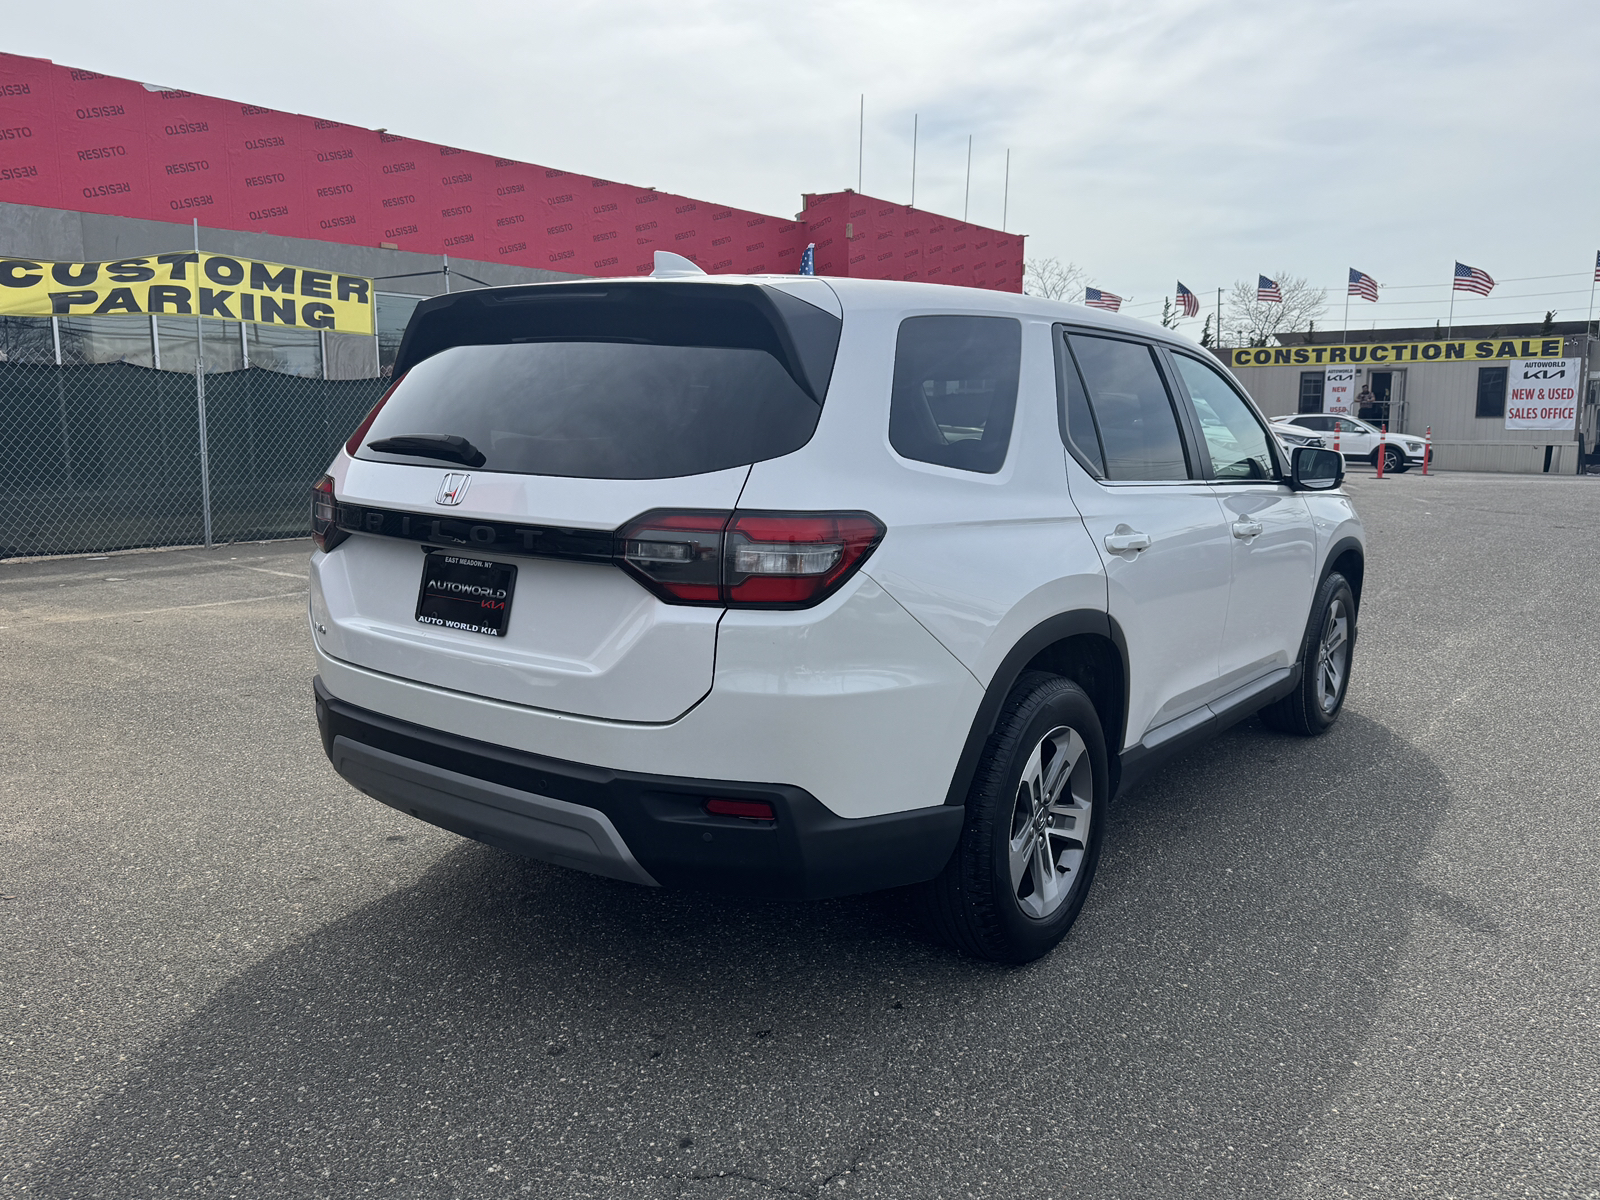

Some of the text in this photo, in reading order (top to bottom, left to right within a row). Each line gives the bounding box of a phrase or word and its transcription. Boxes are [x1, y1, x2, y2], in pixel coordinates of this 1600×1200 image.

[71, 70, 109, 80] RESIS
[160, 90, 197, 100] RESIS
[76, 105, 125, 119] RESISTO
[241, 105, 274, 116] RESIS
[165, 122, 209, 136] RESISTO
[314, 121, 346, 130] RESIS
[245, 136, 285, 150] RESISTO
[77, 146, 126, 160] RESISTO
[317, 149, 354, 162] RESISTO
[166, 160, 210, 175] RESISTO
[382, 162, 416, 174] RESISTO
[245, 174, 285, 187] RESISTO
[442, 173, 472, 186] RESISTO
[83, 182, 131, 198] RESISTO
[317, 184, 353, 198] RESISTO
[497, 184, 525, 196] RESISTO
[170, 195, 214, 210] RESISTO
[382, 195, 416, 208] RESISTO
[547, 194, 573, 206] RESISTO
[249, 206, 288, 220] RESISTO
[442, 205, 472, 218] RESISTO
[320, 216, 356, 230] RESISTO
[496, 215, 524, 227] RESISTO
[385, 224, 418, 238] RESISTO
[547, 223, 573, 235] RESISTO
[444, 234, 474, 247] RESISTO
[593, 231, 617, 242] RESISTO
[499, 242, 527, 255] RESISTO
[549, 250, 575, 262] RESISTO
[0, 253, 368, 304] CUSTOMER
[48, 284, 336, 330] PARKING
[1234, 340, 1560, 365] CONSTRUCTION SALE
[1512, 388, 1574, 400] NEW & USED
[1509, 408, 1574, 419] SALES OFFICE
[366, 512, 542, 550] PILOT
[427, 580, 506, 599] AUTOWORLD
[418, 616, 498, 636] AUTO WORLD KIA
